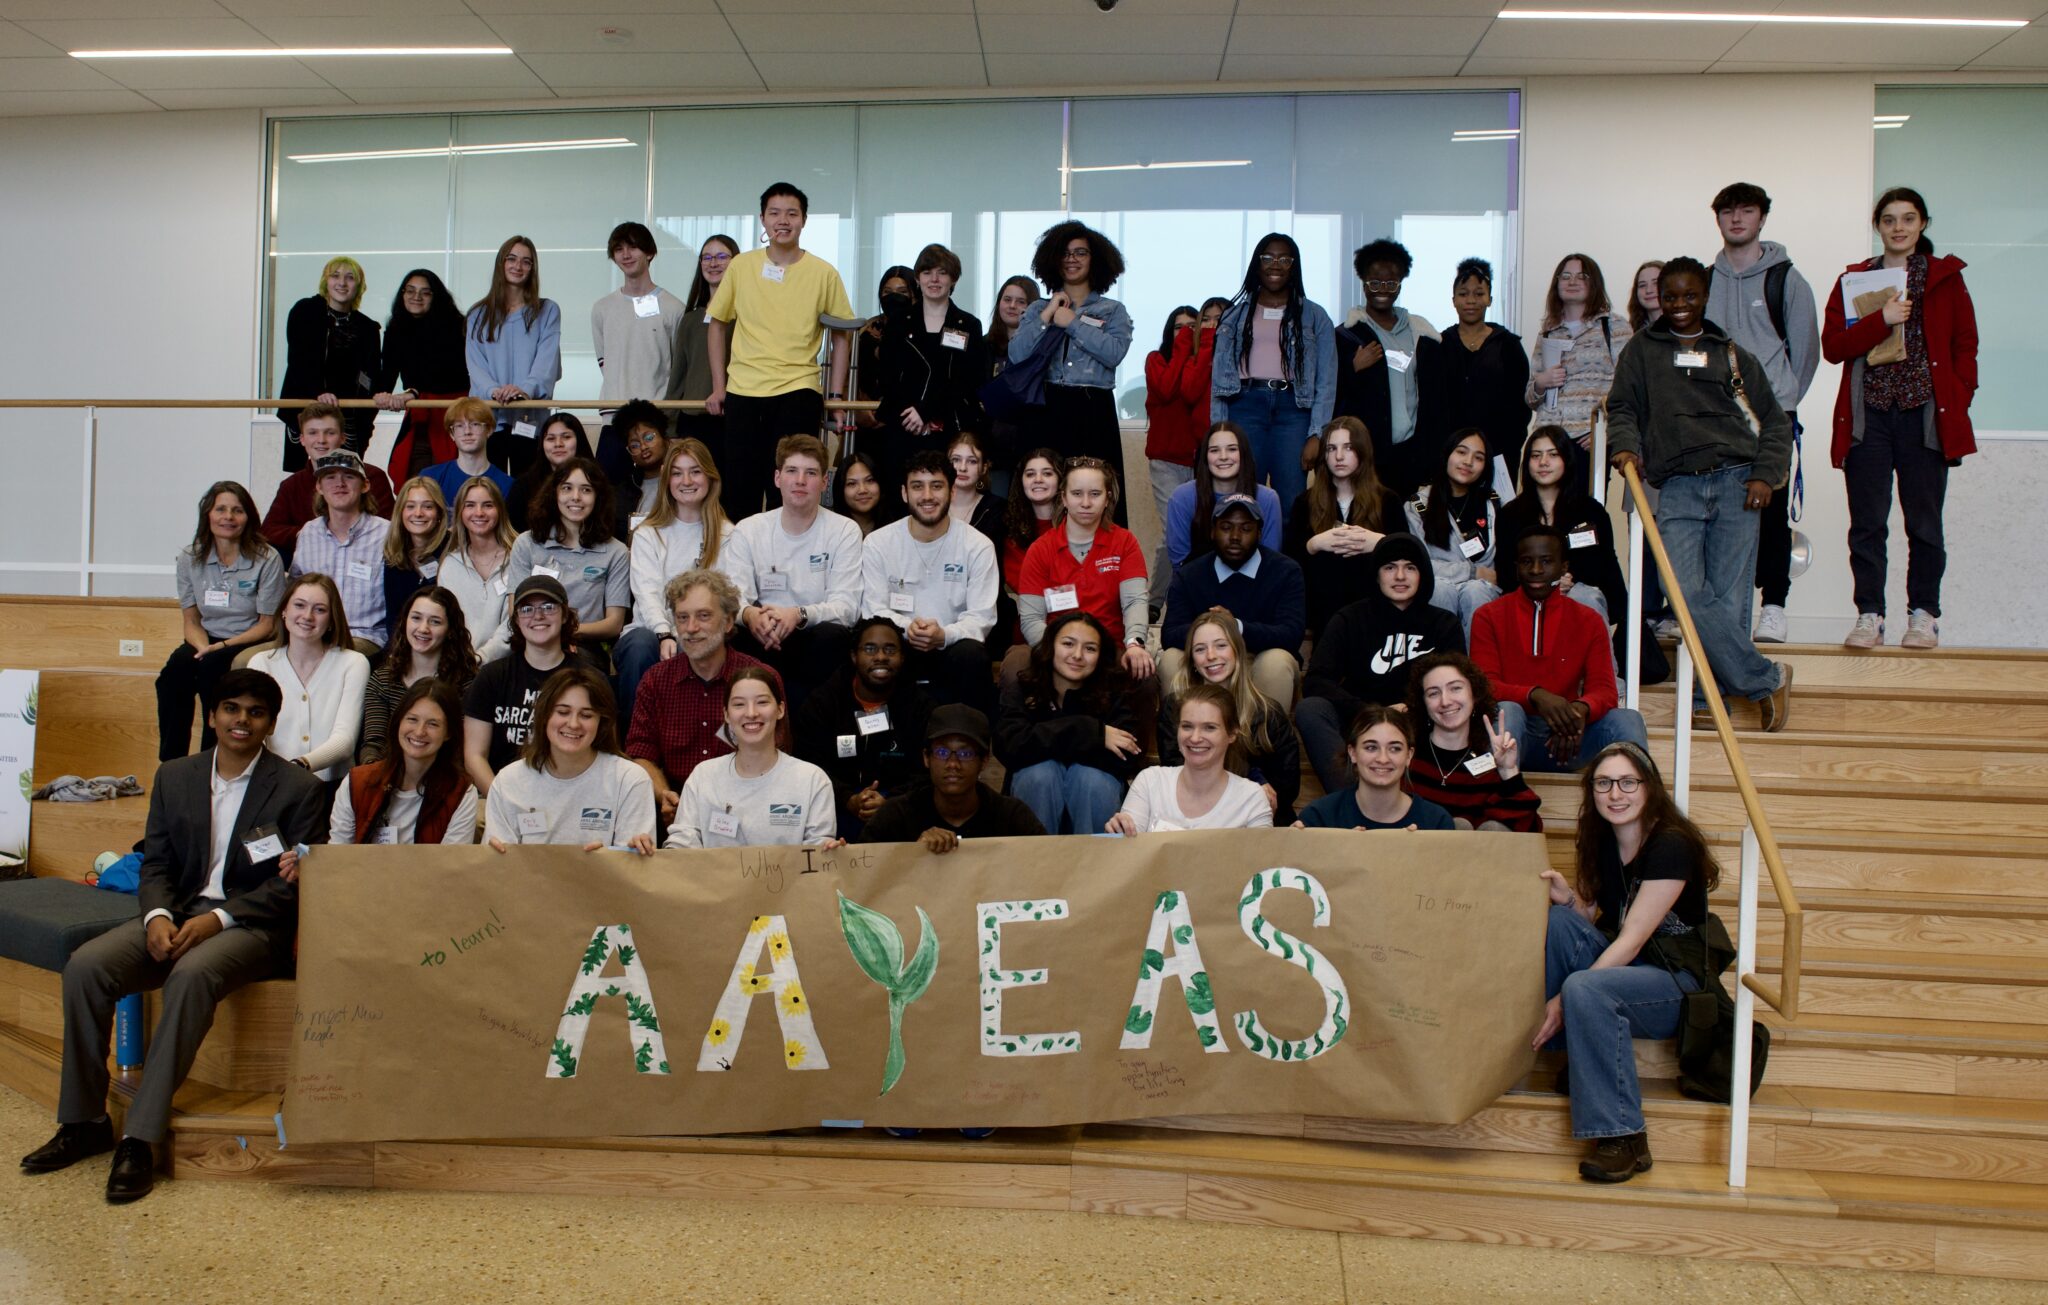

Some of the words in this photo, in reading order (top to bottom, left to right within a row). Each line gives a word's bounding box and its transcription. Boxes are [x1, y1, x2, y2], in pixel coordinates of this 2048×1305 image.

[740, 850, 784, 894] Why
[849, 850, 875, 869] at
[420, 951, 446, 967] to
[450, 907, 506, 954] learn!
